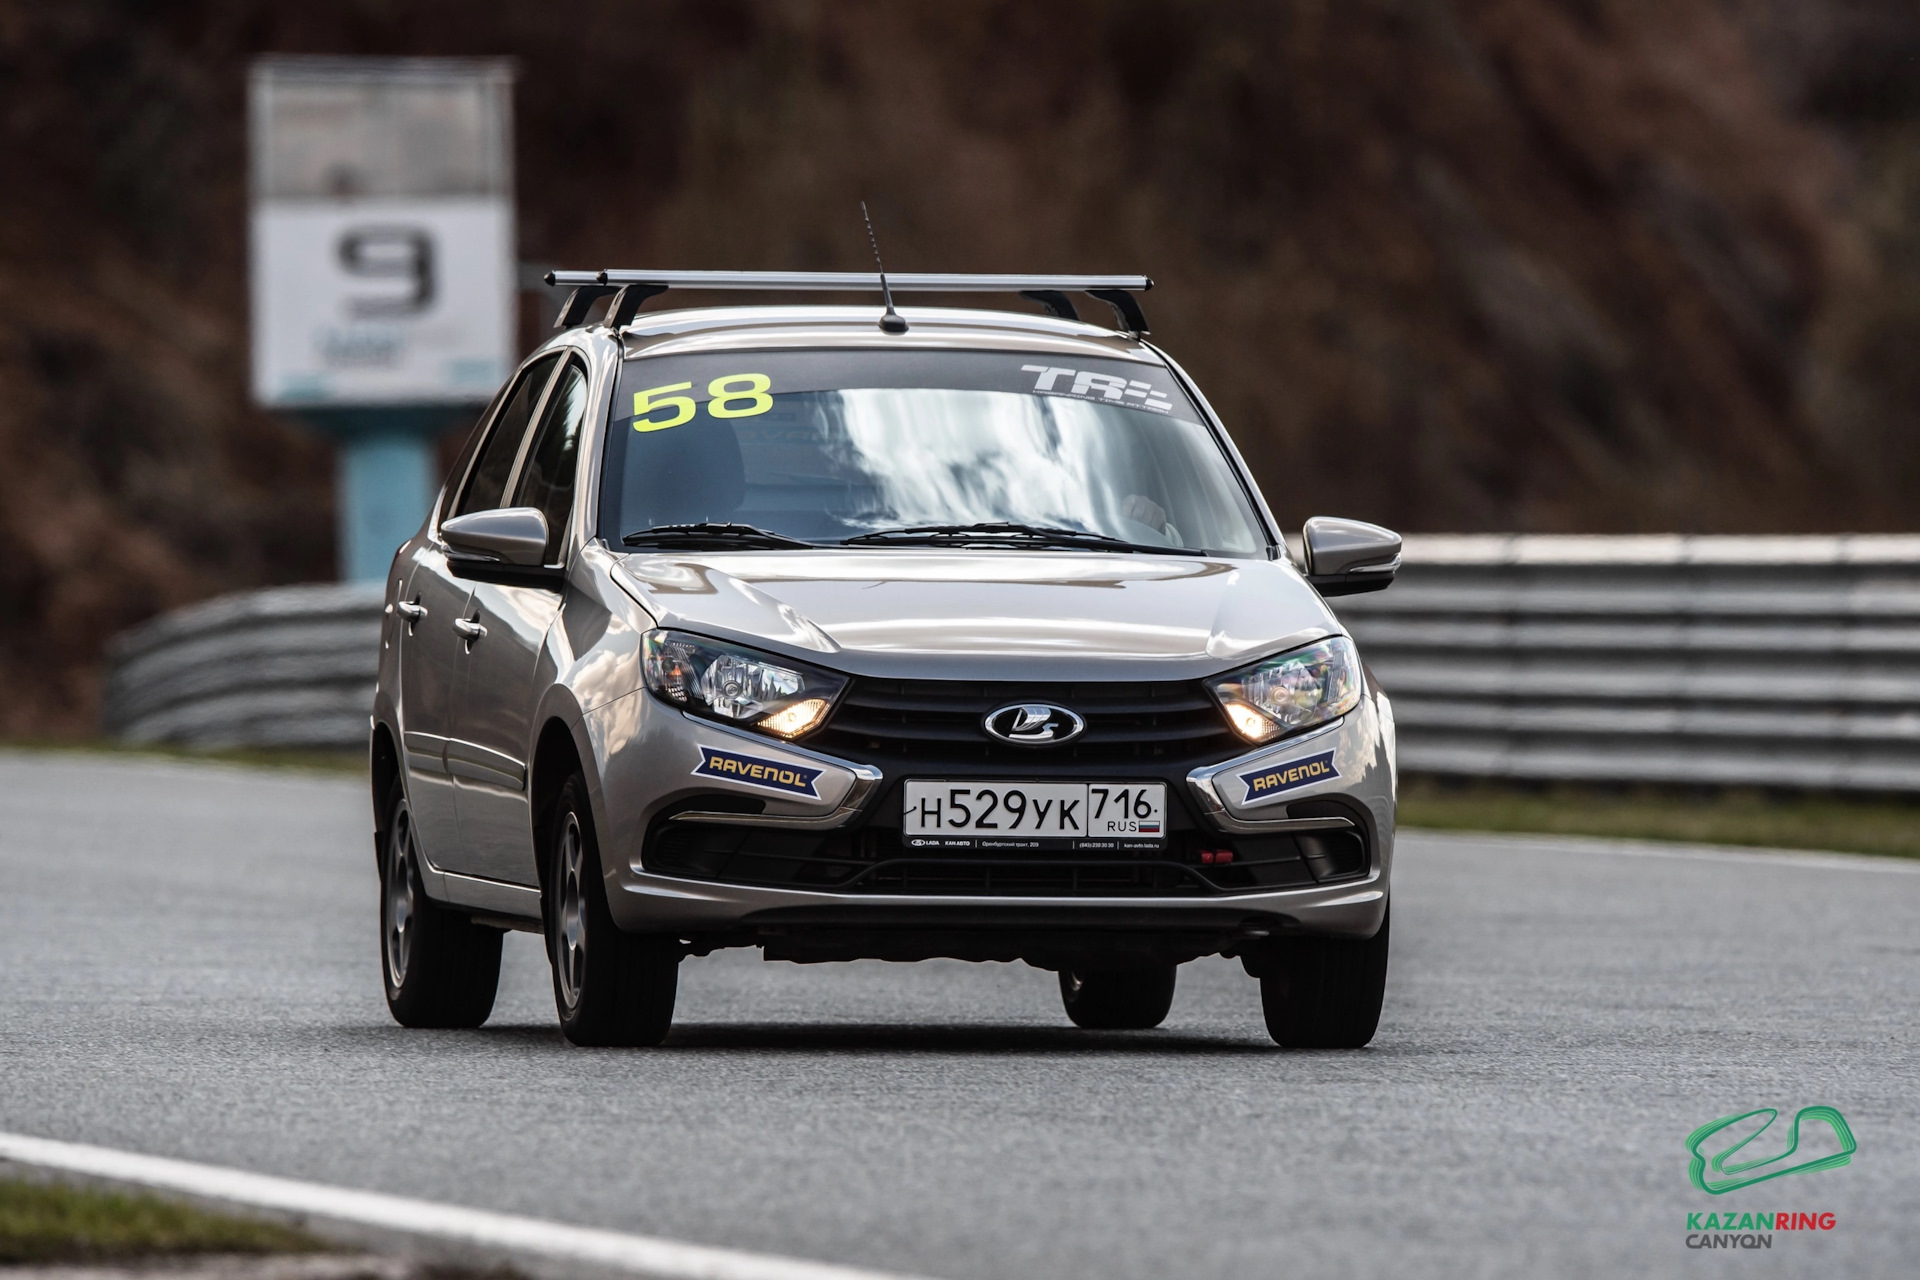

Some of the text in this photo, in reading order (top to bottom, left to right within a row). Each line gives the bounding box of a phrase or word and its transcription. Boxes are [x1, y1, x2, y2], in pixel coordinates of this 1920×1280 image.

[335, 223, 438, 321] 9
[633, 373, 773, 432] 58
[709, 756, 806, 787] RAVENOL
[1253, 761, 1330, 792] RAVENOL
[1091, 788, 1151, 819] 716
[1107, 821, 1137, 832] RUS
